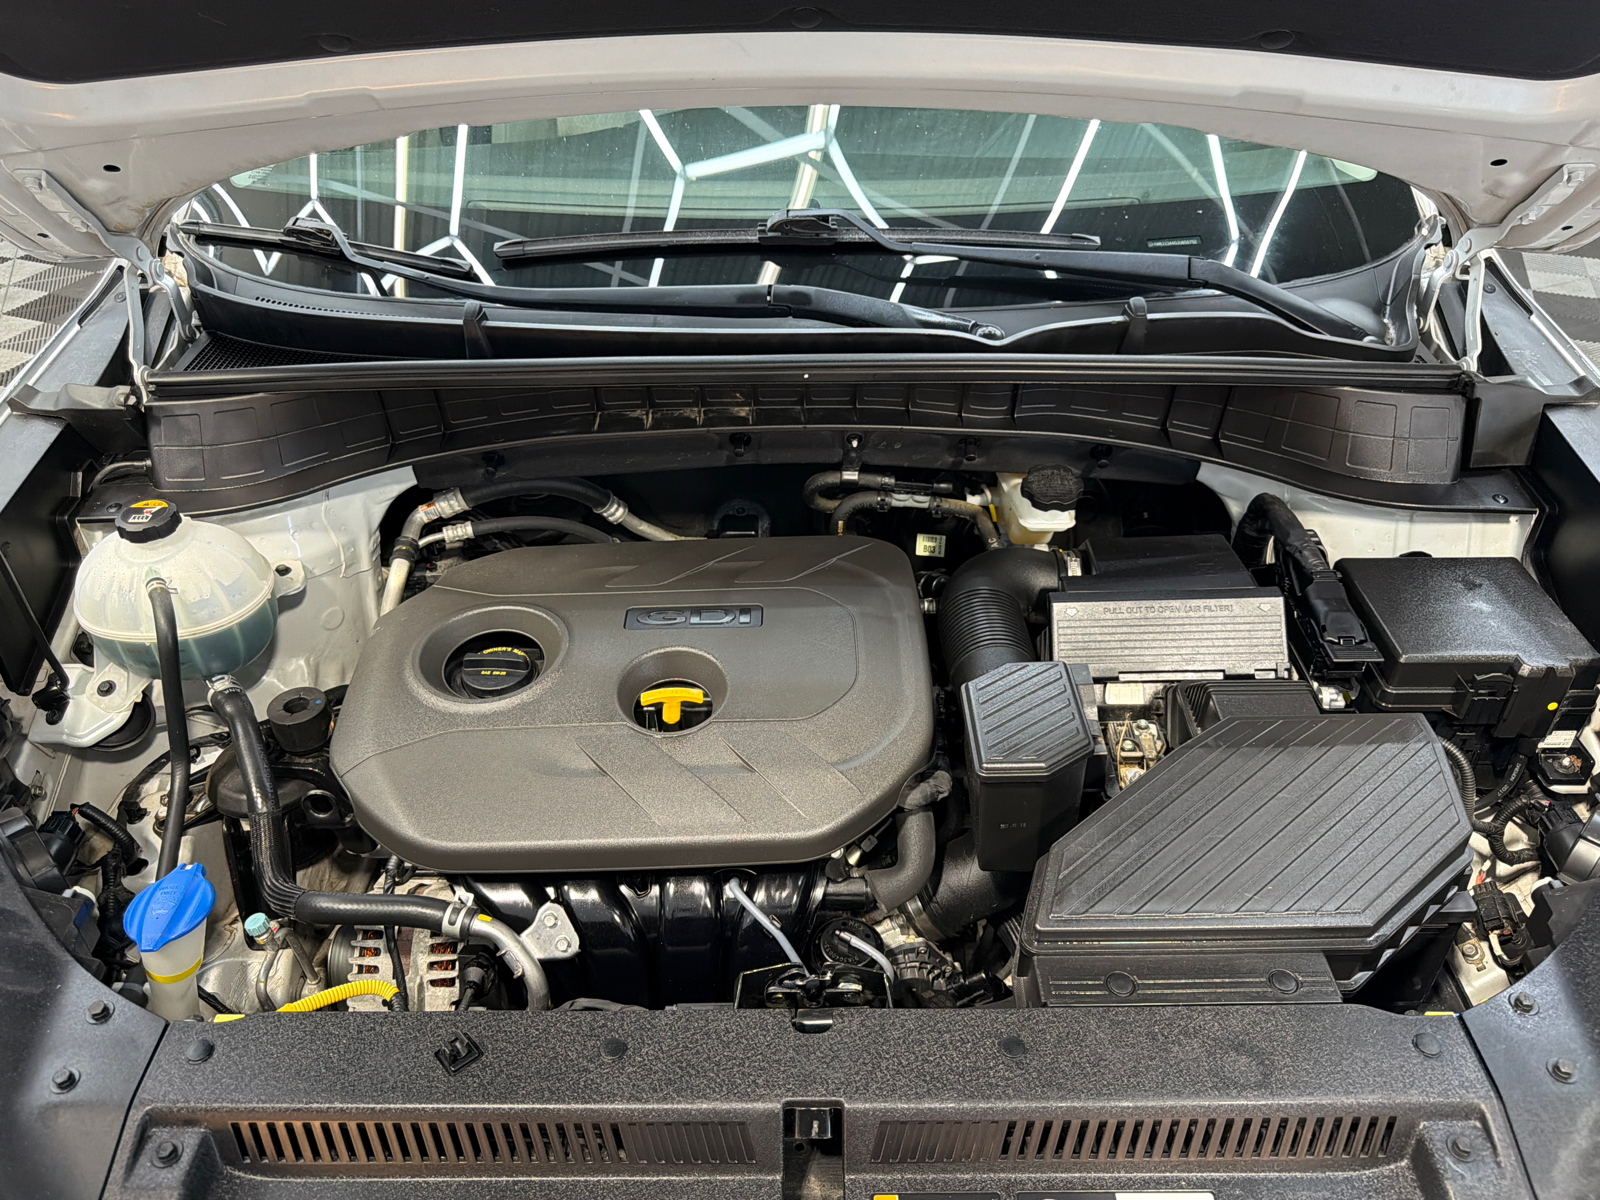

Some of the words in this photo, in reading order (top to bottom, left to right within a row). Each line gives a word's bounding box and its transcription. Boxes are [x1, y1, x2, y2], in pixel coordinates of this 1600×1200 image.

[1103, 607, 1124, 615] PULL
[1126, 606, 1143, 614] OUT
[1145, 606, 1156, 614] TO
[1158, 605, 1180, 614] OPEN
[636, 608, 751, 625] GDI
[483, 646, 512, 655] OWNER'S
